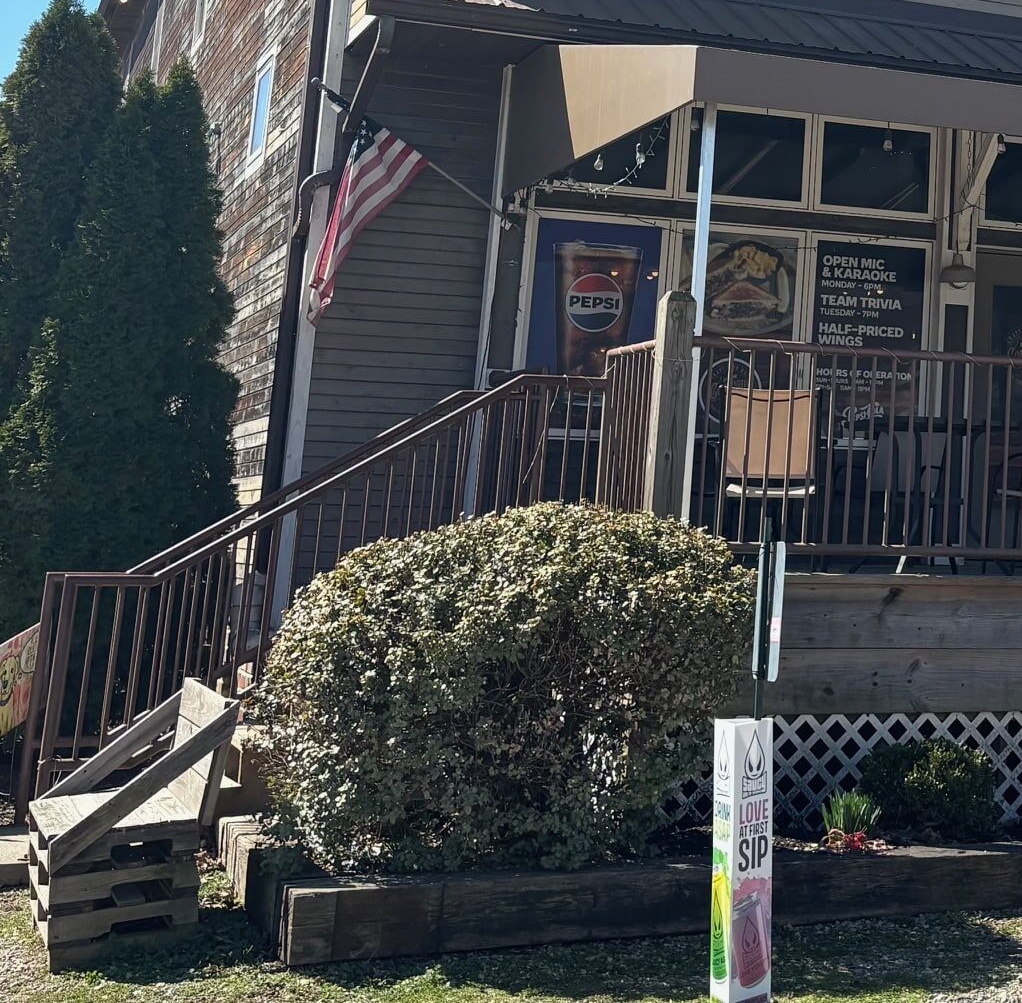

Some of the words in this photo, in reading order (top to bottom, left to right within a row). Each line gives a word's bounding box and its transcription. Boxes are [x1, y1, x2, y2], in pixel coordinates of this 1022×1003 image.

[823, 255, 859, 268] OPEN
[860, 258, 886, 270] MIC
[822, 266, 831, 278] &
[834, 268, 897, 283] KARAOKE
[821, 279, 857, 289] MONDAY
[863, 282, 882, 290] 6PM
[569, 295, 620, 310] PEPSI
[820, 294, 857, 308] TEAM
[859, 297, 902, 310] TRIVIA
[820, 307, 856, 317] TUESDAY
[862, 310, 879, 319] 7PM
[818, 322, 904, 338] HALF-PRICED
[817, 334, 864, 347] WINGS
[739, 799, 768, 825] LOVE
[739, 825, 748, 839] AT
[749, 820, 768, 837] FIRST
[738, 834, 768, 873] SIP
